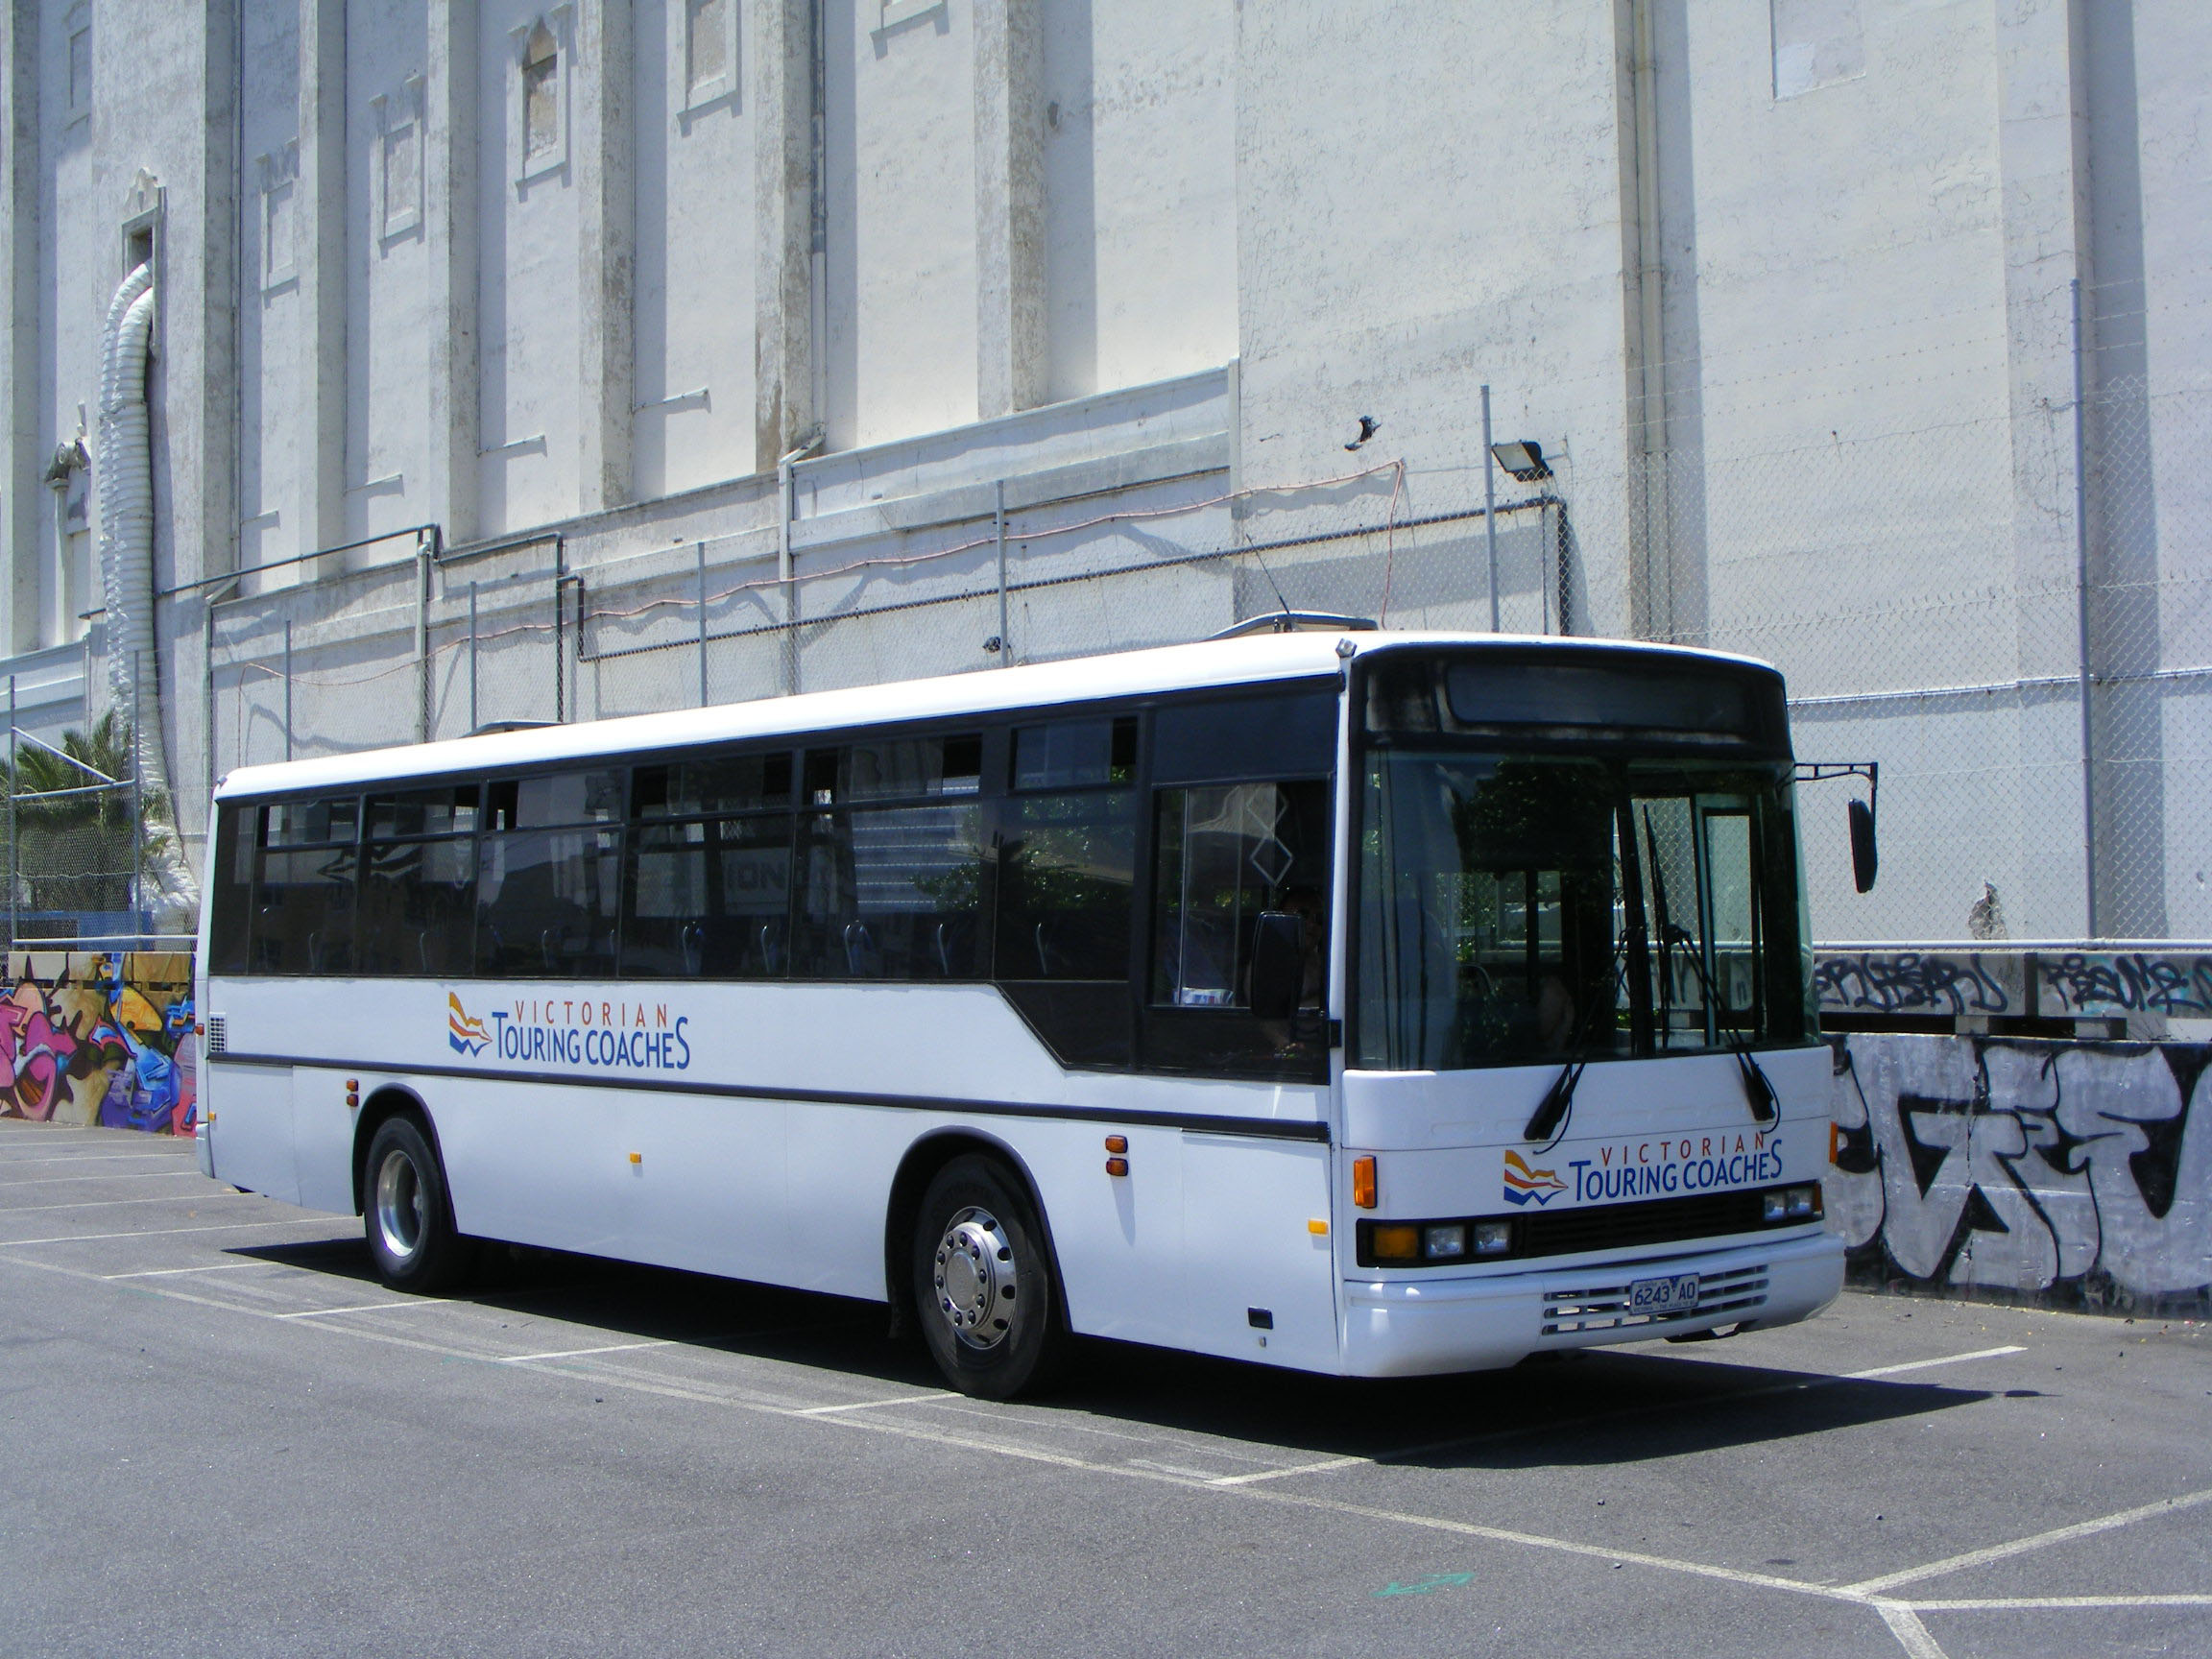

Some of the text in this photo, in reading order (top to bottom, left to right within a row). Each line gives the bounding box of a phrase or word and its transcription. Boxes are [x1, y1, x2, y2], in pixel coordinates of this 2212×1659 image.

[516, 999, 667, 1028] VICTORIAN
[492, 1011, 690, 1070] TOURING COACHES
[1601, 1131, 1765, 1166] VICTORIAN
[1569, 1139, 1783, 1201] TOURING COACHES
[1634, 1285, 1671, 1306] 6243
